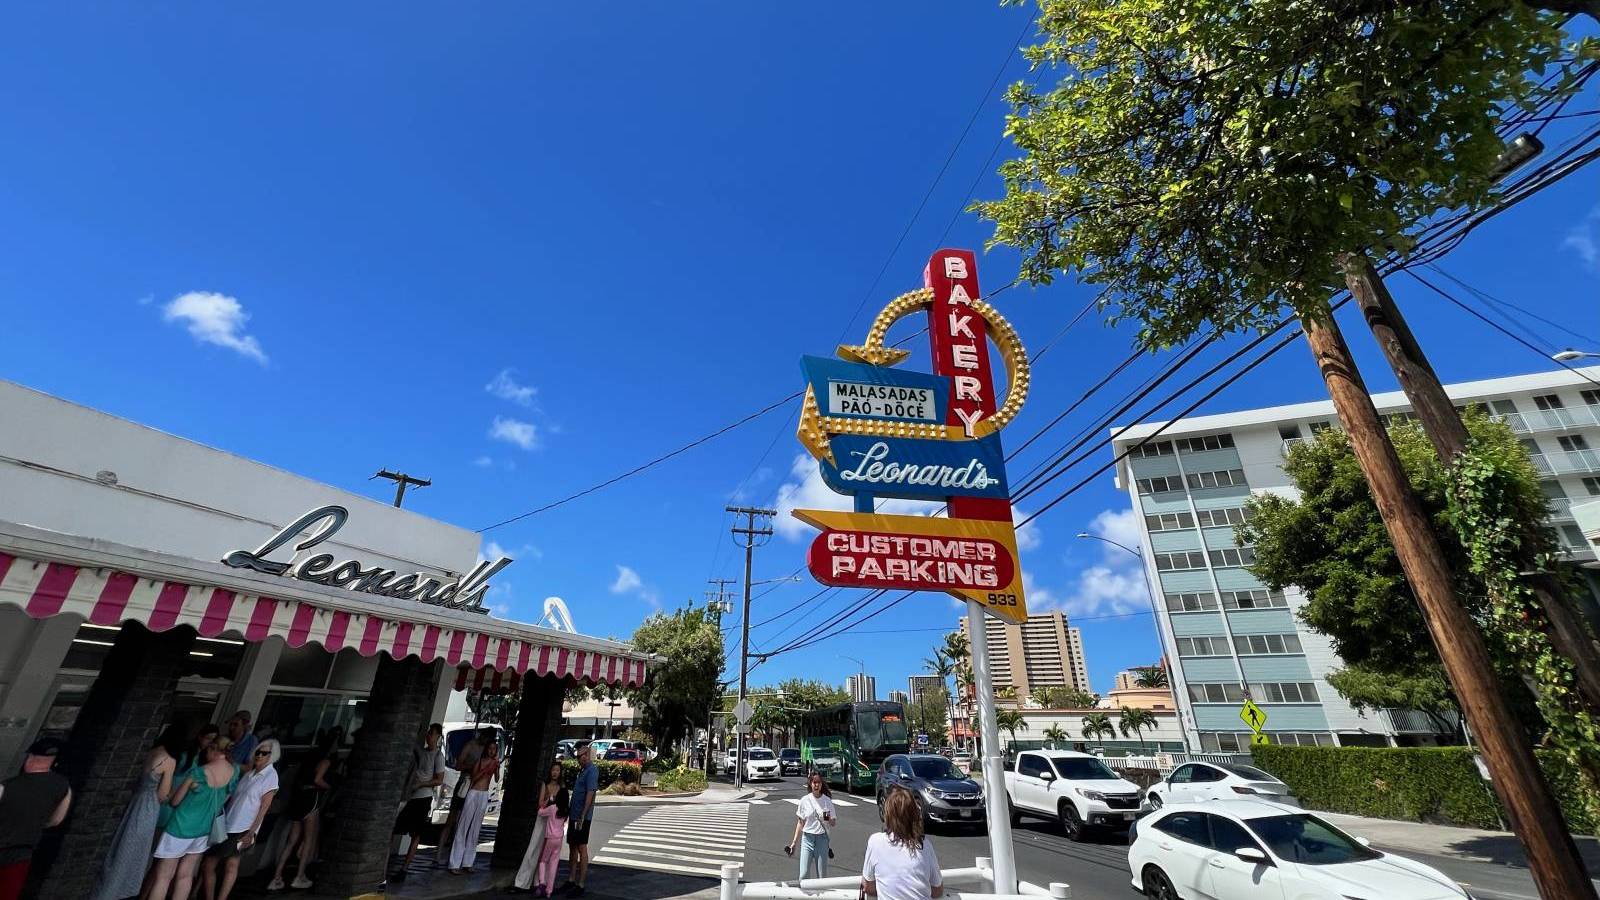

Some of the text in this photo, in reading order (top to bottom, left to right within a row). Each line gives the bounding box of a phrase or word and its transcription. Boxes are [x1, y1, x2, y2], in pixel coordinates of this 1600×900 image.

[944, 257, 984, 438] BAKERY
[836, 384, 927, 402] MALASADAS
[841, 442, 998, 489] Leonard's
[220, 505, 514, 615] Leonard's
[827, 533, 997, 562] CUSTOMER
[831, 555, 998, 587] PARKING
[987, 593, 1017, 607] 933
